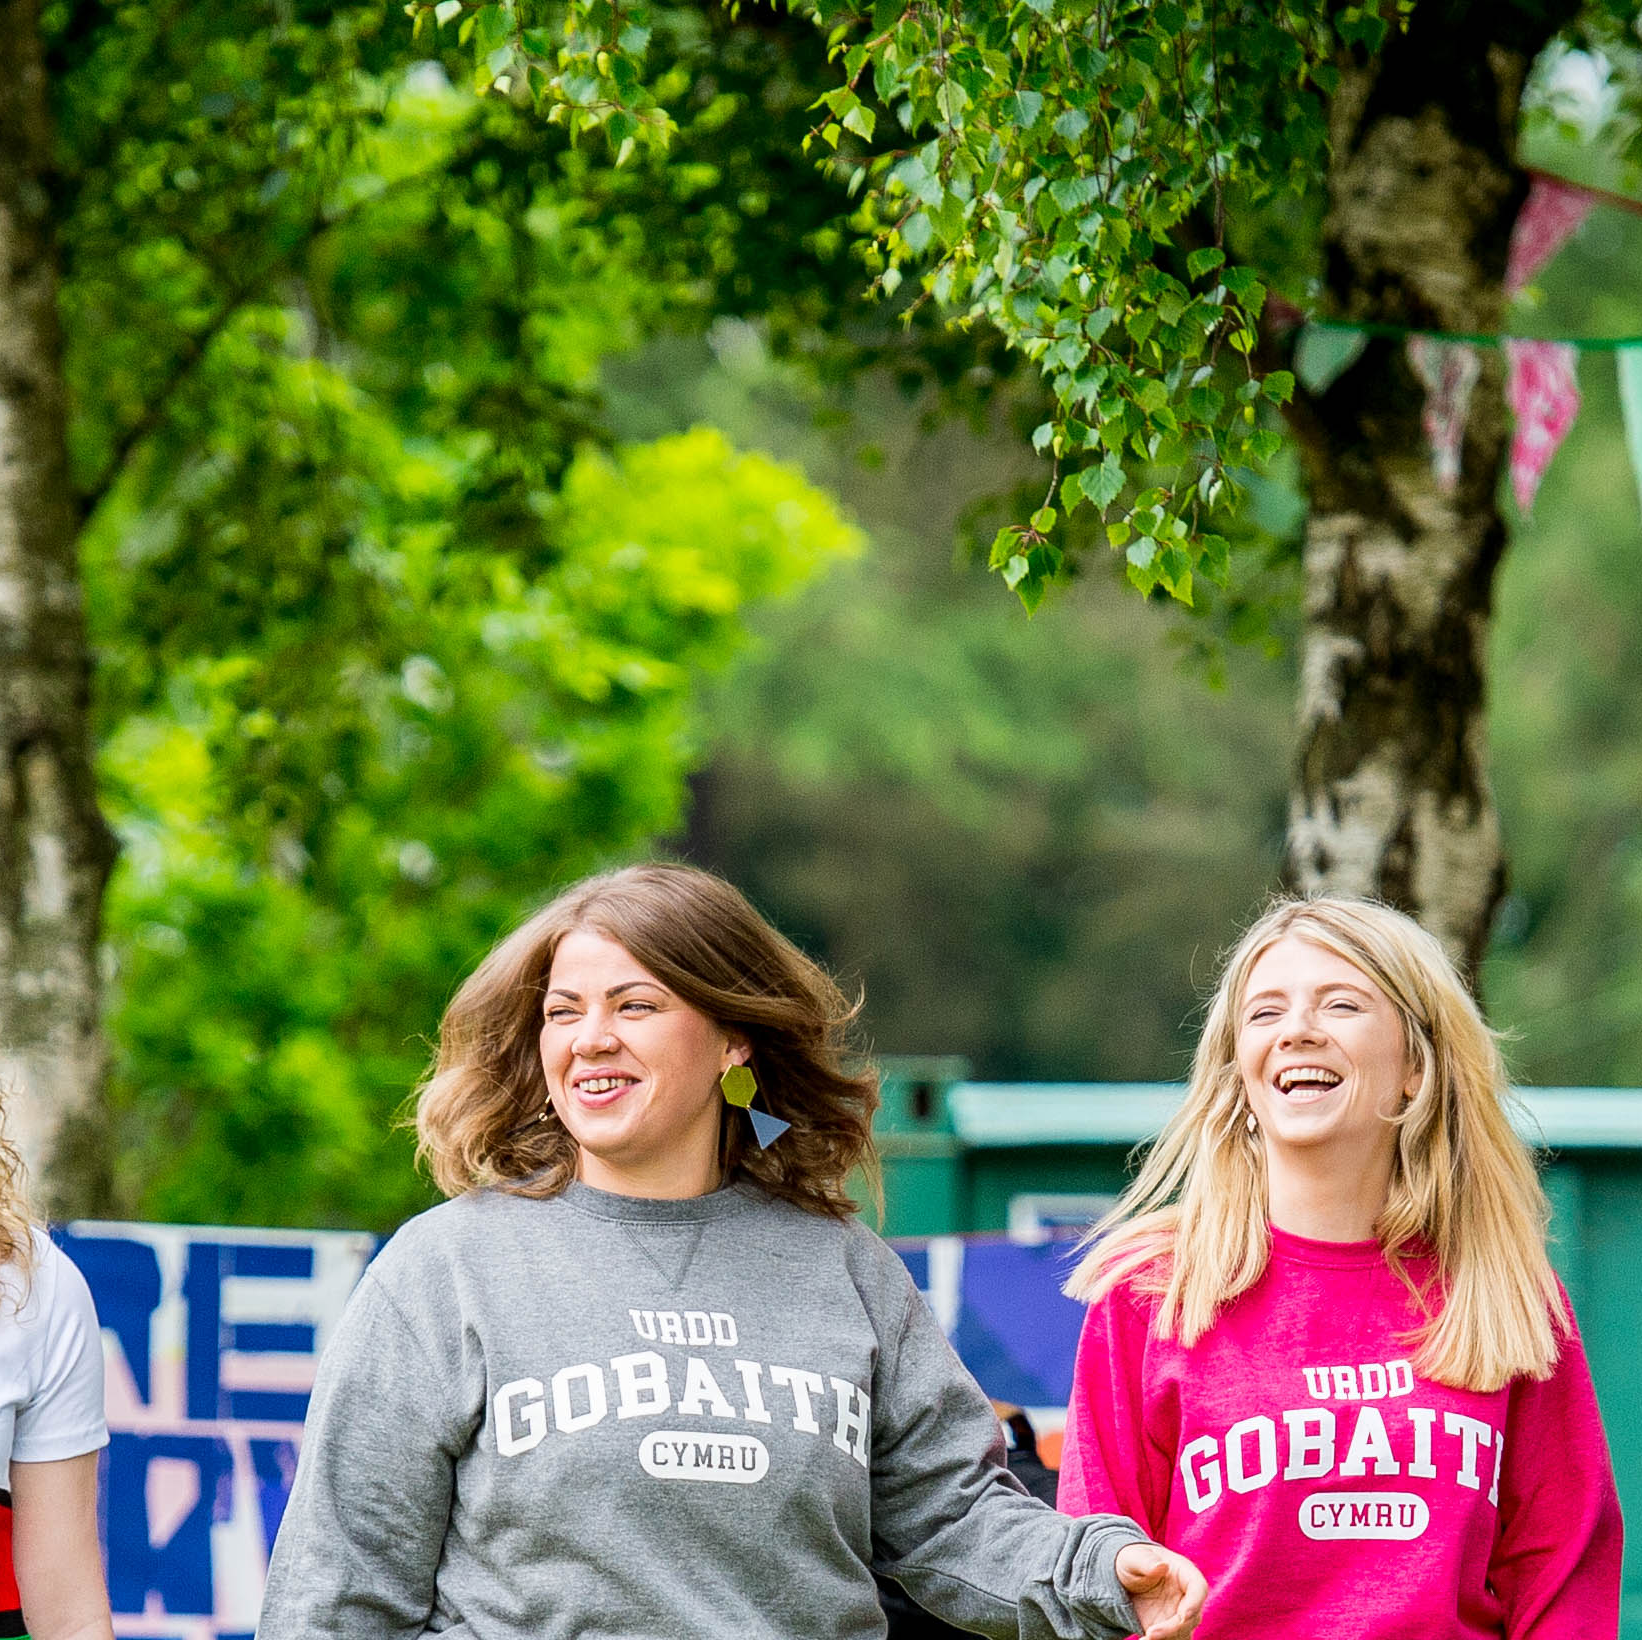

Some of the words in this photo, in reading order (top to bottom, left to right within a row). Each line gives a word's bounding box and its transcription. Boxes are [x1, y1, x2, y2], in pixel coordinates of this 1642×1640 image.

[628, 1308, 739, 1347] URDD
[1302, 1360, 1414, 1400] URDD
[493, 1351, 870, 1468] GOBAITH
[652, 1442, 758, 1471] CYMRU
[1310, 1503, 1417, 1528] CYMRU
